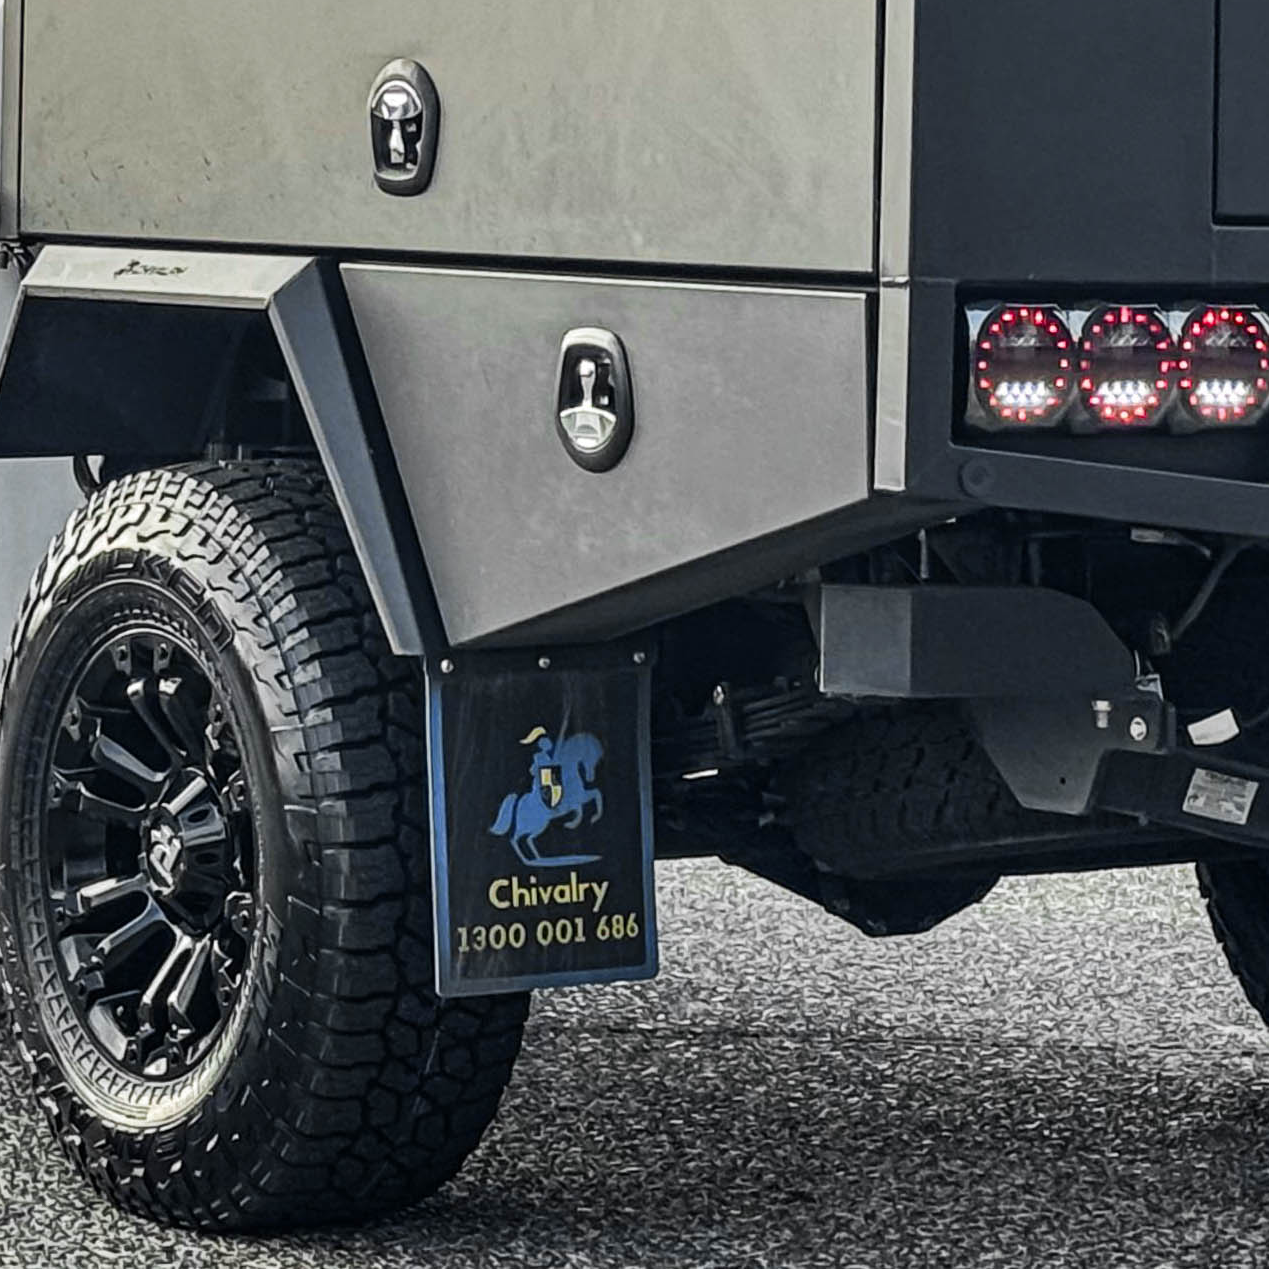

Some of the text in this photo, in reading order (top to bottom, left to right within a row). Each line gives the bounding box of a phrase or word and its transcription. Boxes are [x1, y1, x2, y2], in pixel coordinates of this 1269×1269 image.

[488, 871, 609, 912] Chivalry
[457, 912, 639, 952] 1300 001 686
